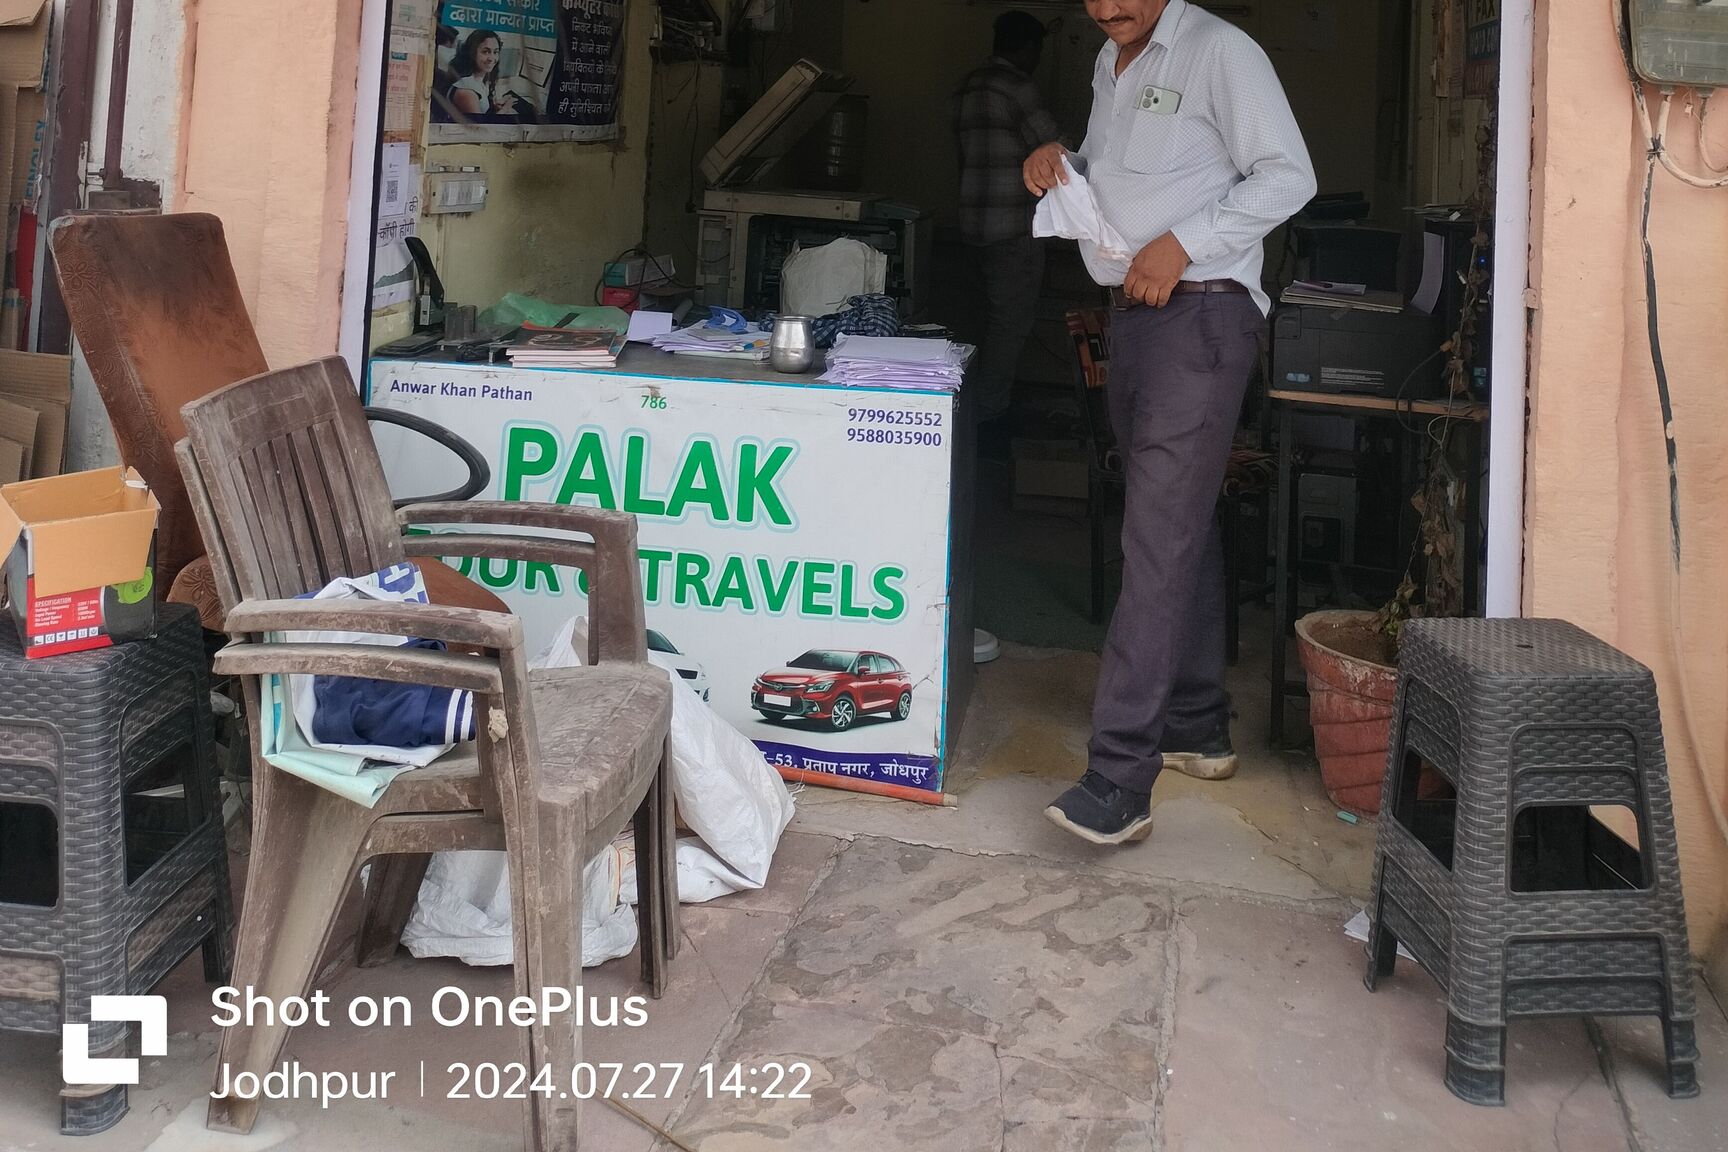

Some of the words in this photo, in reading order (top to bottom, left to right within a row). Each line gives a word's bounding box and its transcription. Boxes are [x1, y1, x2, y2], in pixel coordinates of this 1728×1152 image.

[390, 379, 437, 398] Anwar
[440, 381, 478, 400] Khan
[481, 383, 533, 402] Pathan
[640, 395, 667, 410] 786
[847, 407, 943, 427] 9799625552
[846, 427, 943, 447] 9588035900
[505, 427, 794, 526] PALAK
[638, 549, 905, 620] TRAVELS
[801, 756, 838, 775] प्रताप
[879, 758, 930, 785] जोधपुर
